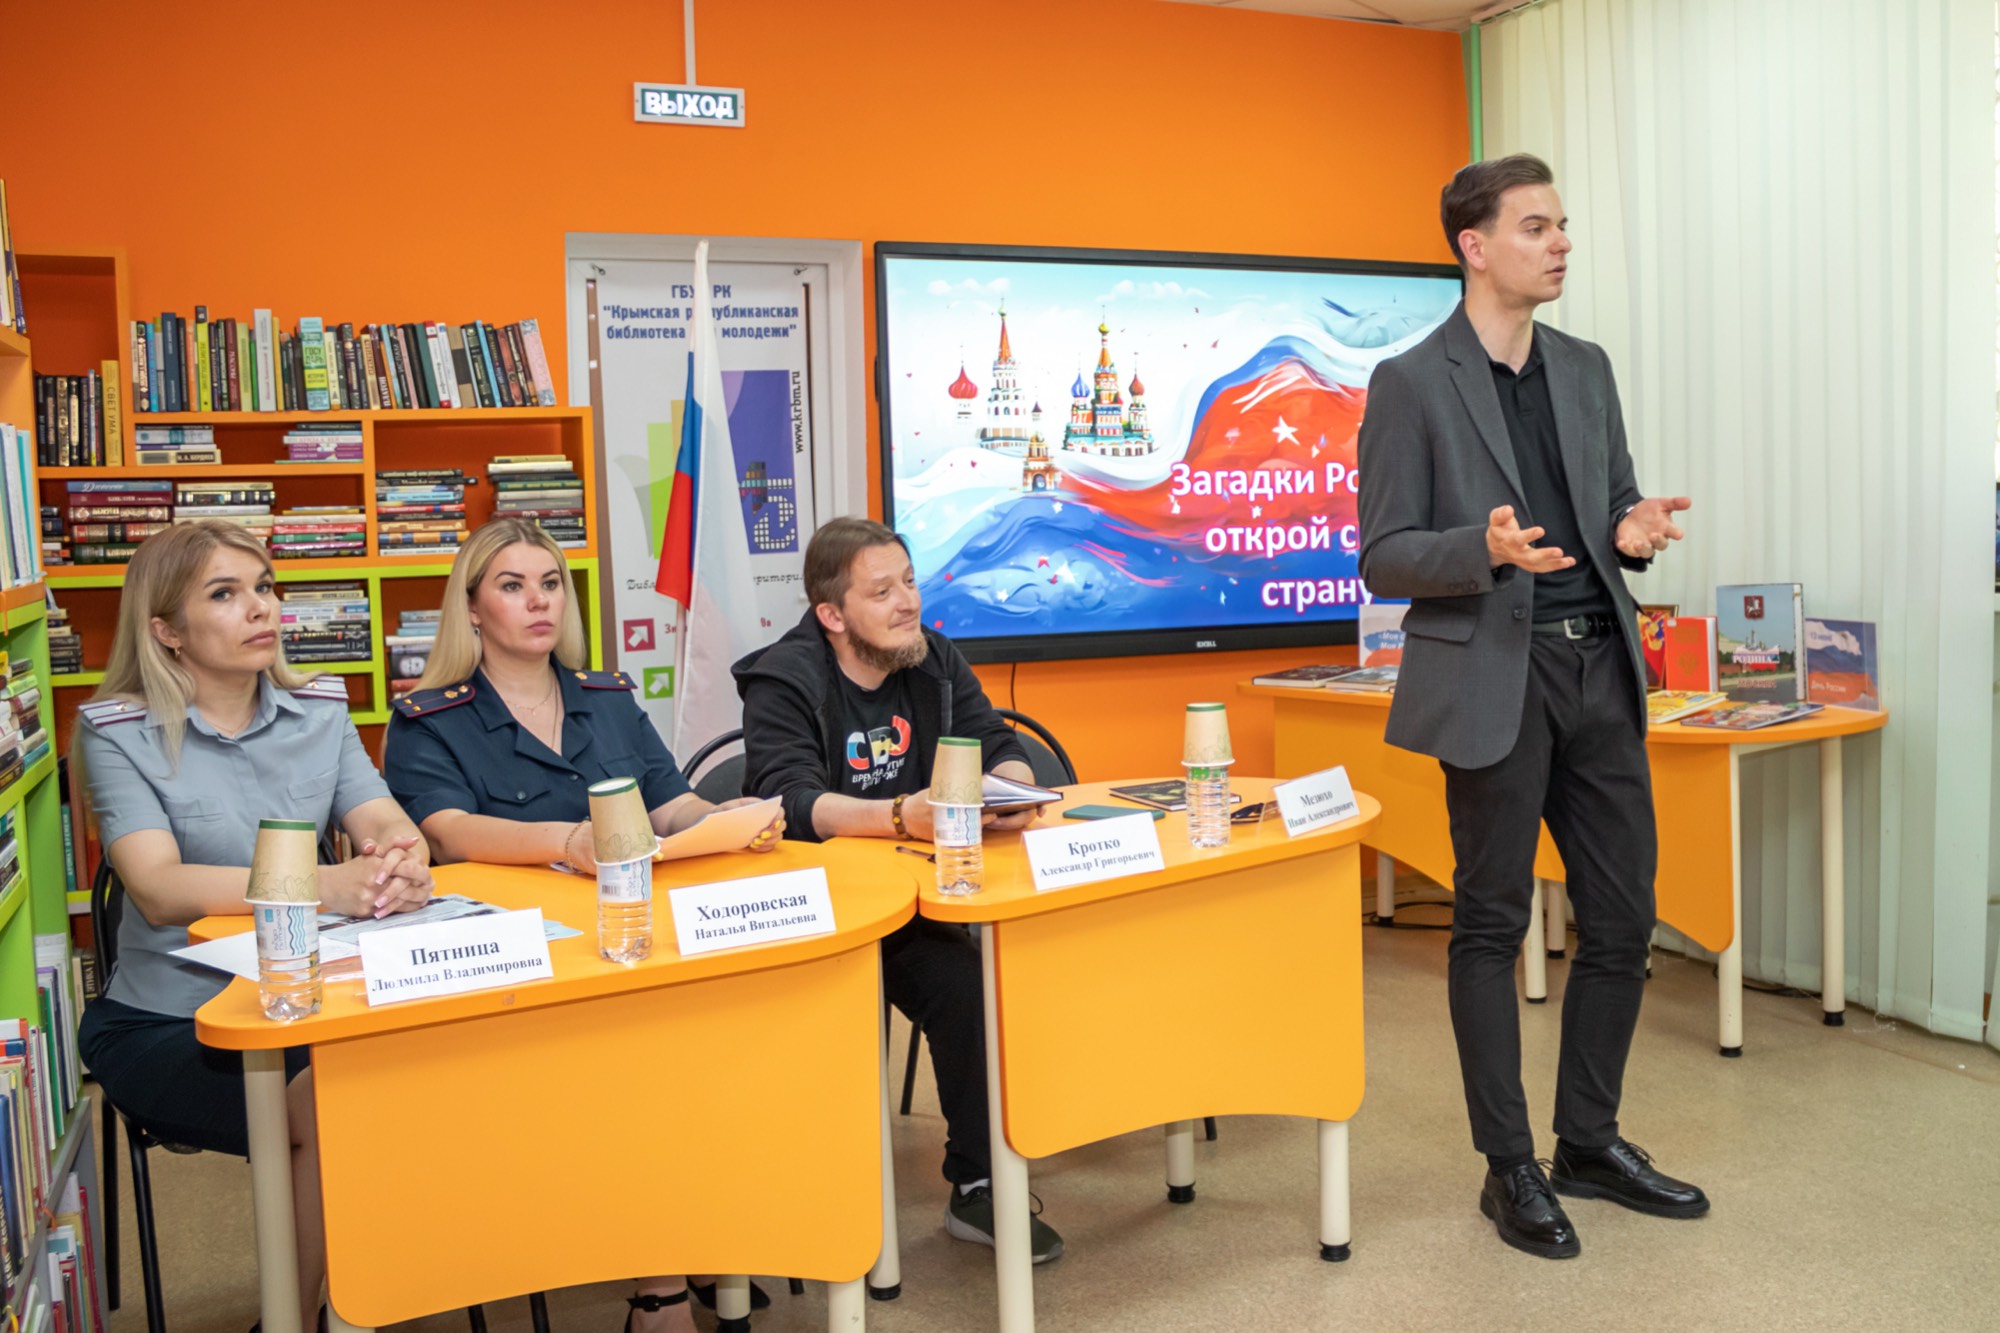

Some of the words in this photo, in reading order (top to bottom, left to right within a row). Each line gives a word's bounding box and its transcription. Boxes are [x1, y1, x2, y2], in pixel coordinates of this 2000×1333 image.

[645, 91, 735, 120] ВЫХОД
[713, 284, 731, 298] РК
[606, 325, 686, 339] библиотека
[790, 371, 804, 454] www.krbm.ru
[1171, 463, 1314, 501] Загадки
[1205, 515, 1330, 558] открой
[1068, 837, 1121, 857] Кротко
[1039, 859, 1093, 878] Александр
[1094, 850, 1155, 870] Григорьевич
[696, 894, 808, 922] Ходоровская
[695, 923, 747, 941] Наталья
[749, 913, 817, 932] Витальевна
[410, 940, 501, 967] Пятница
[372, 972, 440, 992] Людмила
[443, 957, 543, 981] Владимировна
